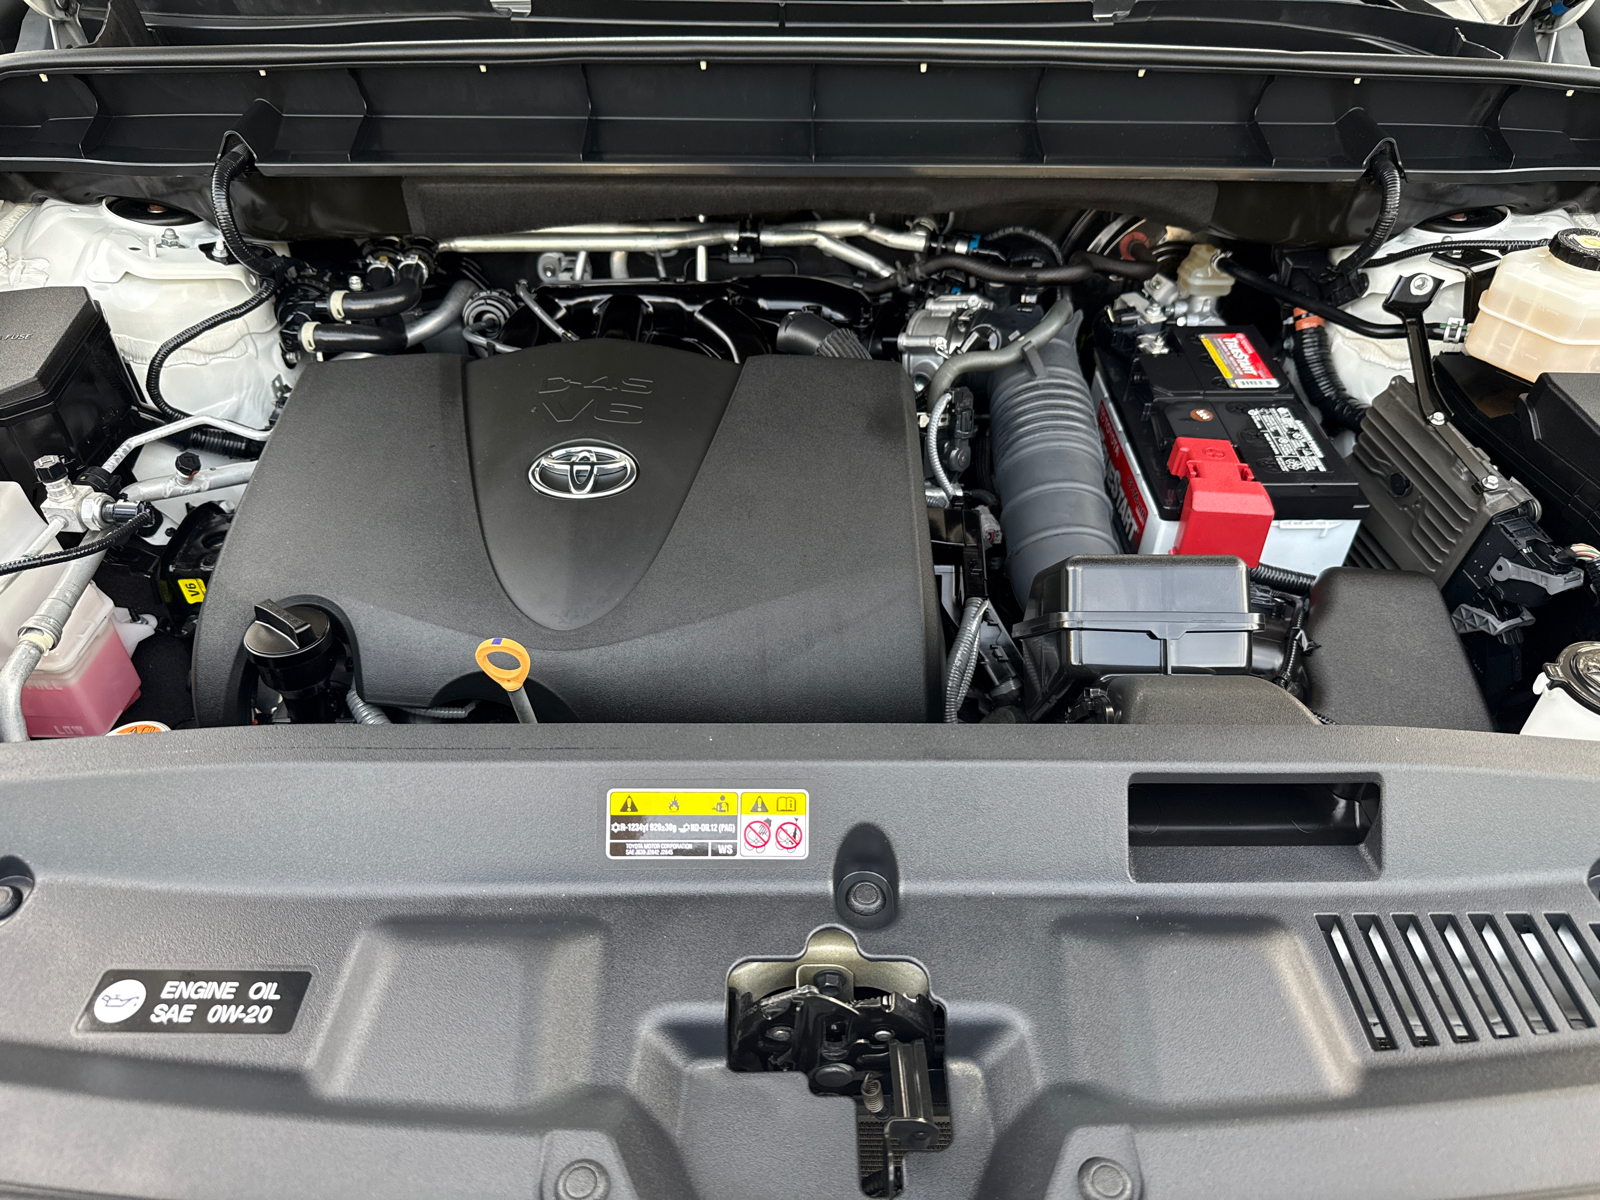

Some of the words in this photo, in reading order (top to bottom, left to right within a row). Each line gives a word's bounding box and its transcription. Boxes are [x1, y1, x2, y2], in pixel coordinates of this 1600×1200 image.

[4, 333, 34, 341] FUSE
[542, 399, 643, 425] V6
[185, 582, 200, 597] V6
[53, 725, 85, 735] LOW
[718, 844, 733, 854] WS
[160, 981, 239, 999] ENGINE
[248, 982, 281, 1000] OIL
[150, 1004, 197, 1024] SAE
[207, 1005, 273, 1023] 0W-20
